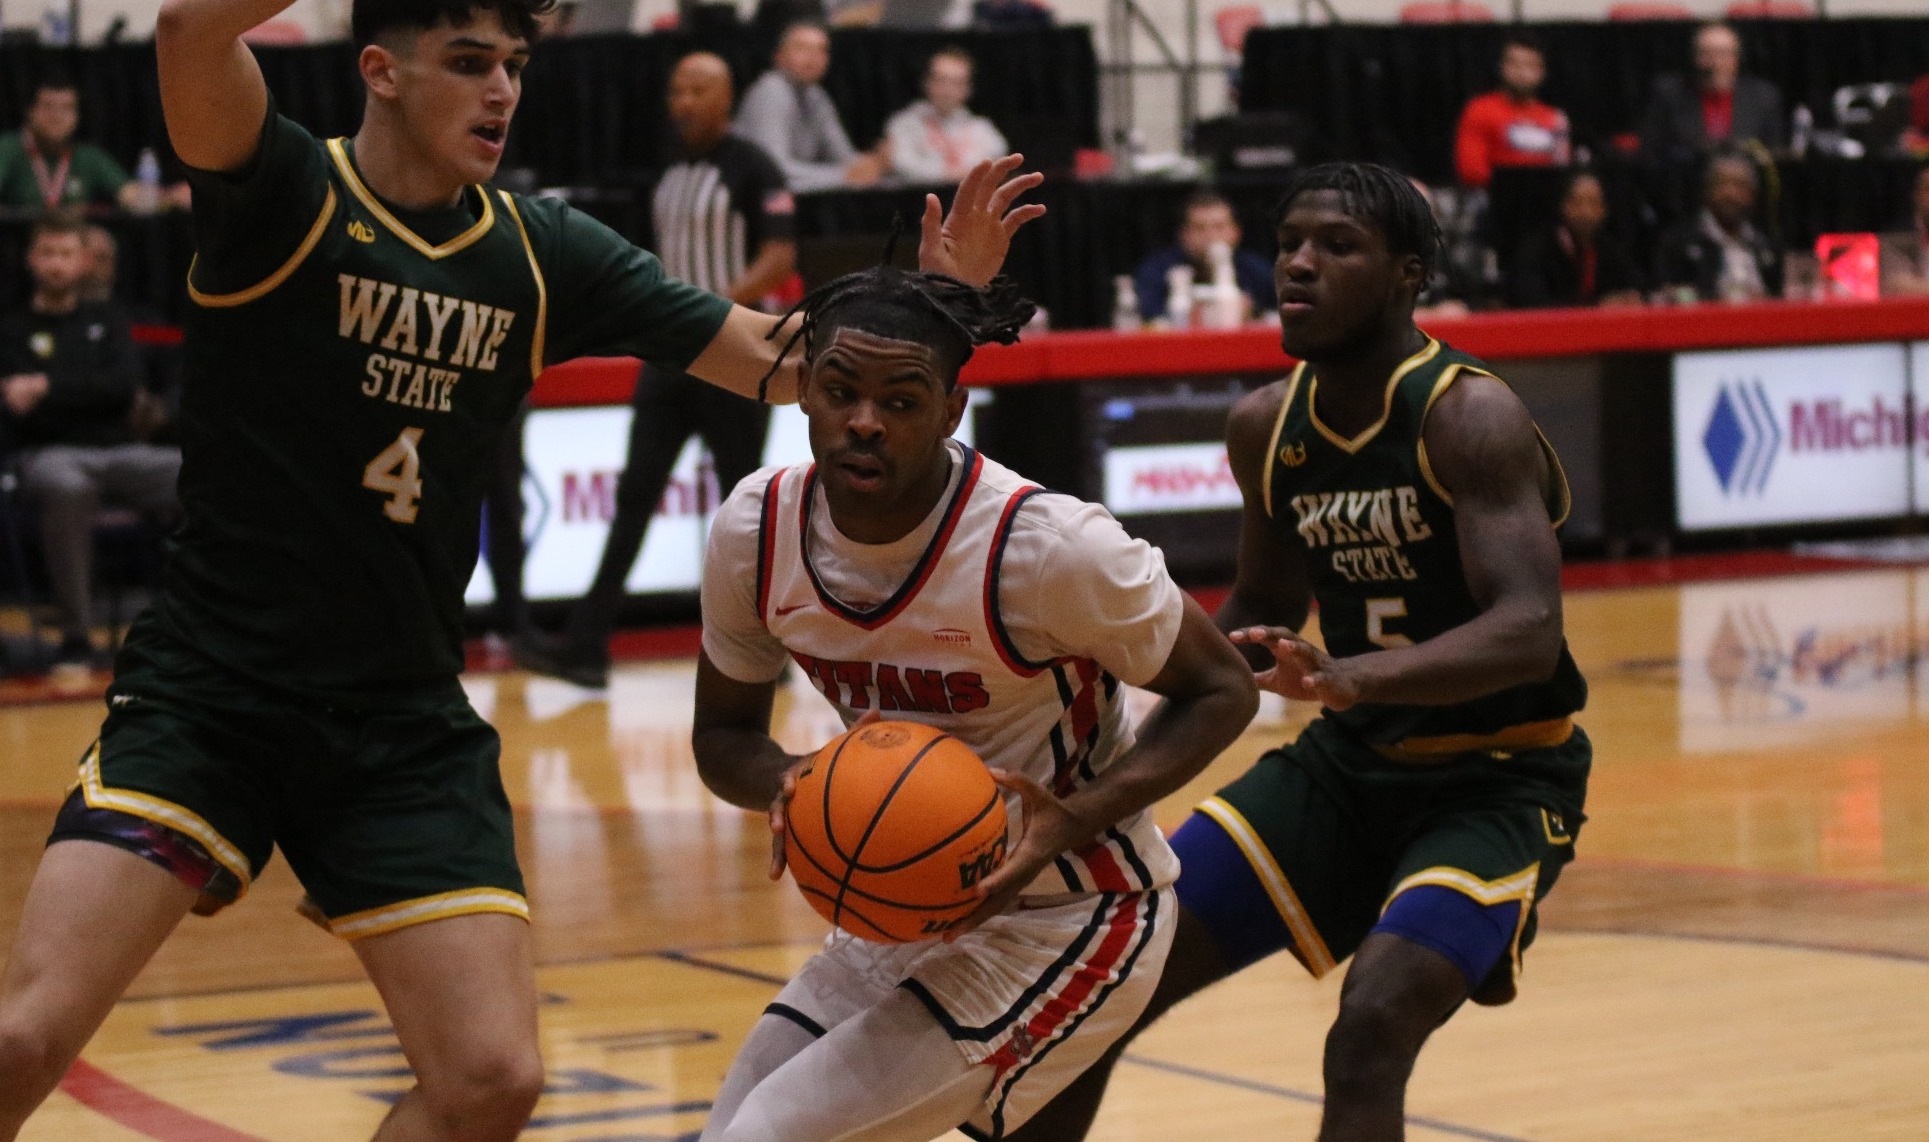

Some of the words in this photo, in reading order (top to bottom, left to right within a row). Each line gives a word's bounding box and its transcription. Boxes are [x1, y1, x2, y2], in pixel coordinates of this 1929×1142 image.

[338, 273, 516, 371] WAYNE
[362, 353, 461, 412] STATE
[362, 426, 425, 524] 4
[1291, 486, 1432, 548] WAYNE
[1332, 547, 1418, 582] STATE
[933, 634, 971, 643] HORIZON
[1366, 598, 1416, 650] 5
